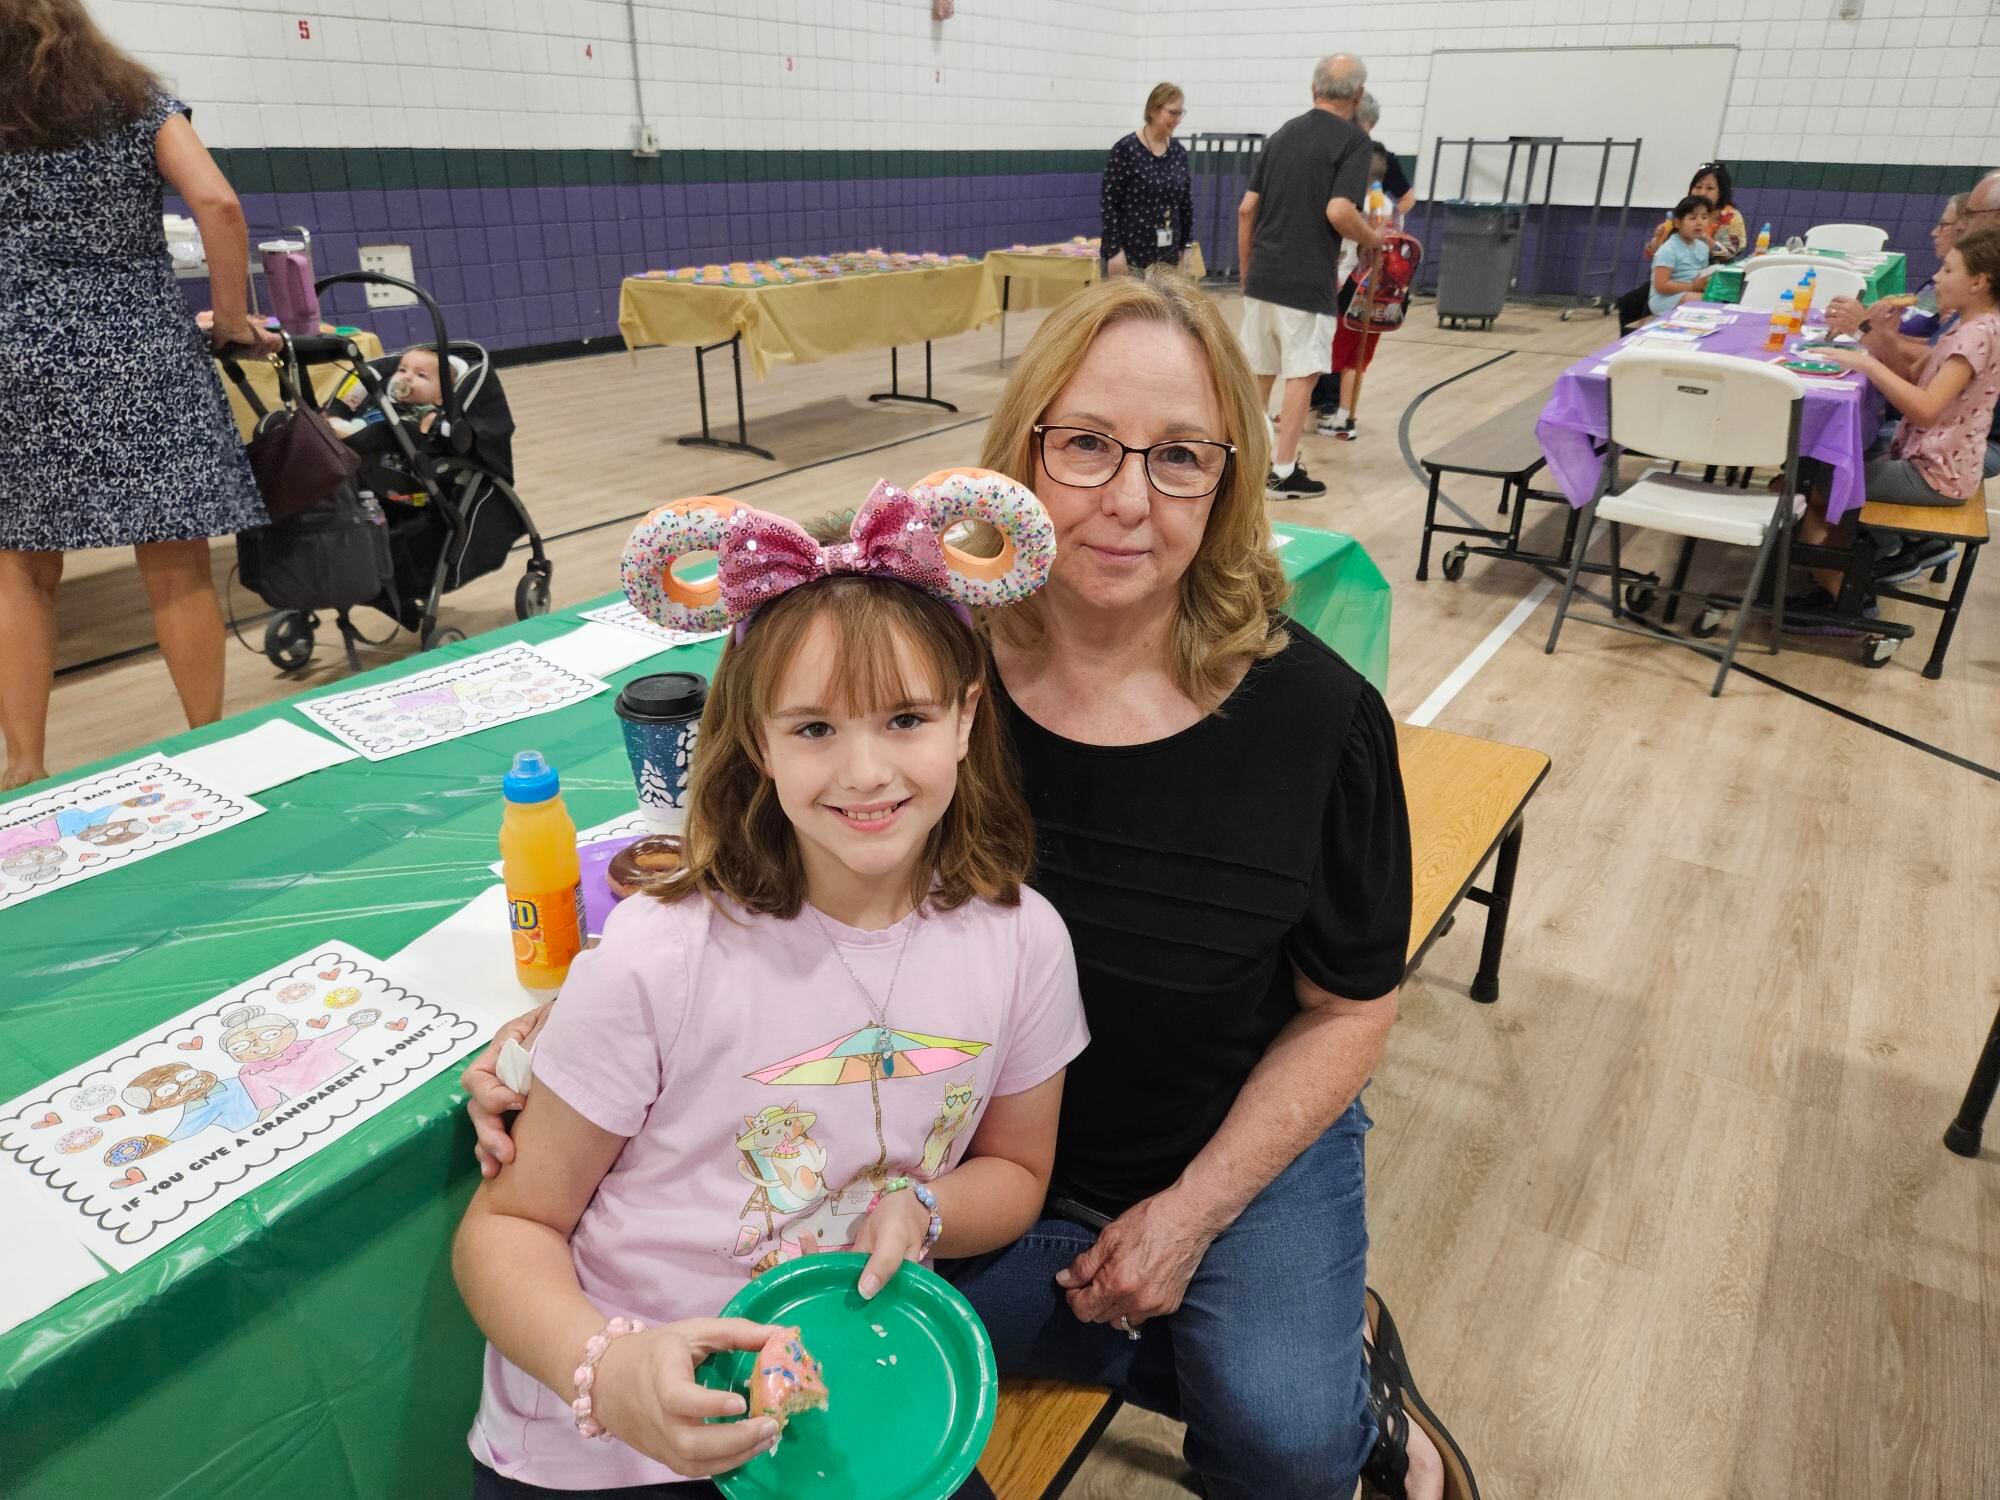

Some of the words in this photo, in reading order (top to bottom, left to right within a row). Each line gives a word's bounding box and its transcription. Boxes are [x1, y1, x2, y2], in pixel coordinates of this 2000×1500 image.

[298, 20, 310, 40] 5
[585, 43, 593, 60] 4
[935, 70, 941, 84] 2
[145, 773, 157, 782] IF
[115, 780, 142, 791] YOU
[84, 789, 112, 801] GIVE
[121, 1197, 142, 1213] IF
[145, 1172, 185, 1196] YOU
[188, 1146, 232, 1172] GIVE
[235, 1138, 250, 1148] A
[251, 1065, 368, 1137] GRANDPARENT
[371, 1057, 386, 1067] A
